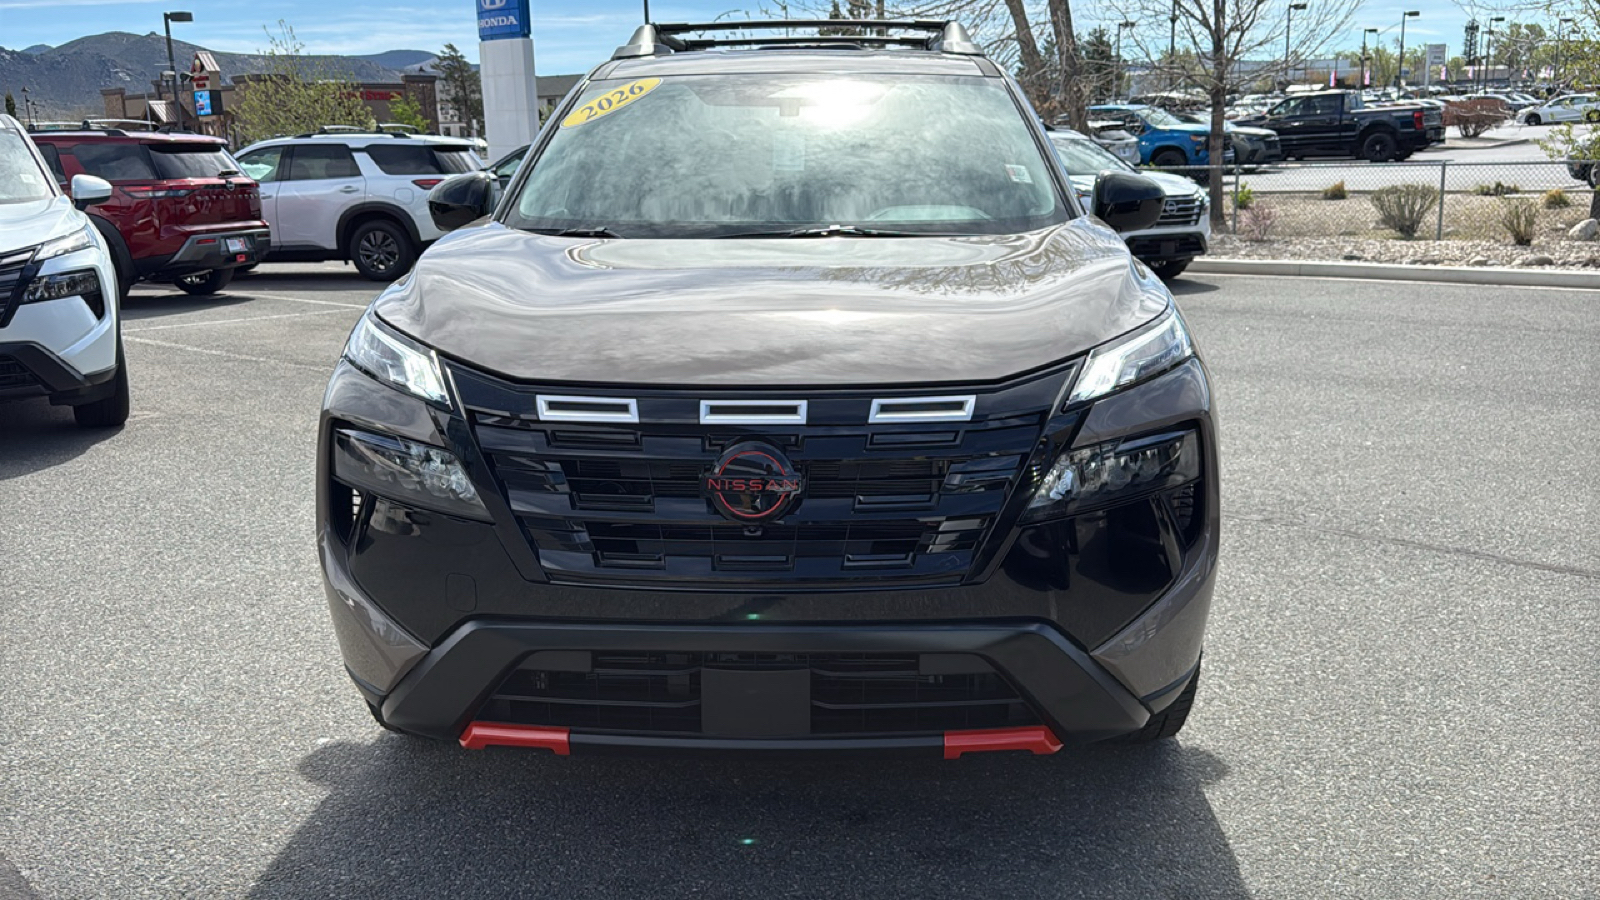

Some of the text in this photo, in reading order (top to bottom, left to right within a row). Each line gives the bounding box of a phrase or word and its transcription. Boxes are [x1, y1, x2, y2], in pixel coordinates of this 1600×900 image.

[479, 15, 518, 28] HONDA
[581, 82, 644, 120] 2026
[708, 479, 797, 490] NISSAN
